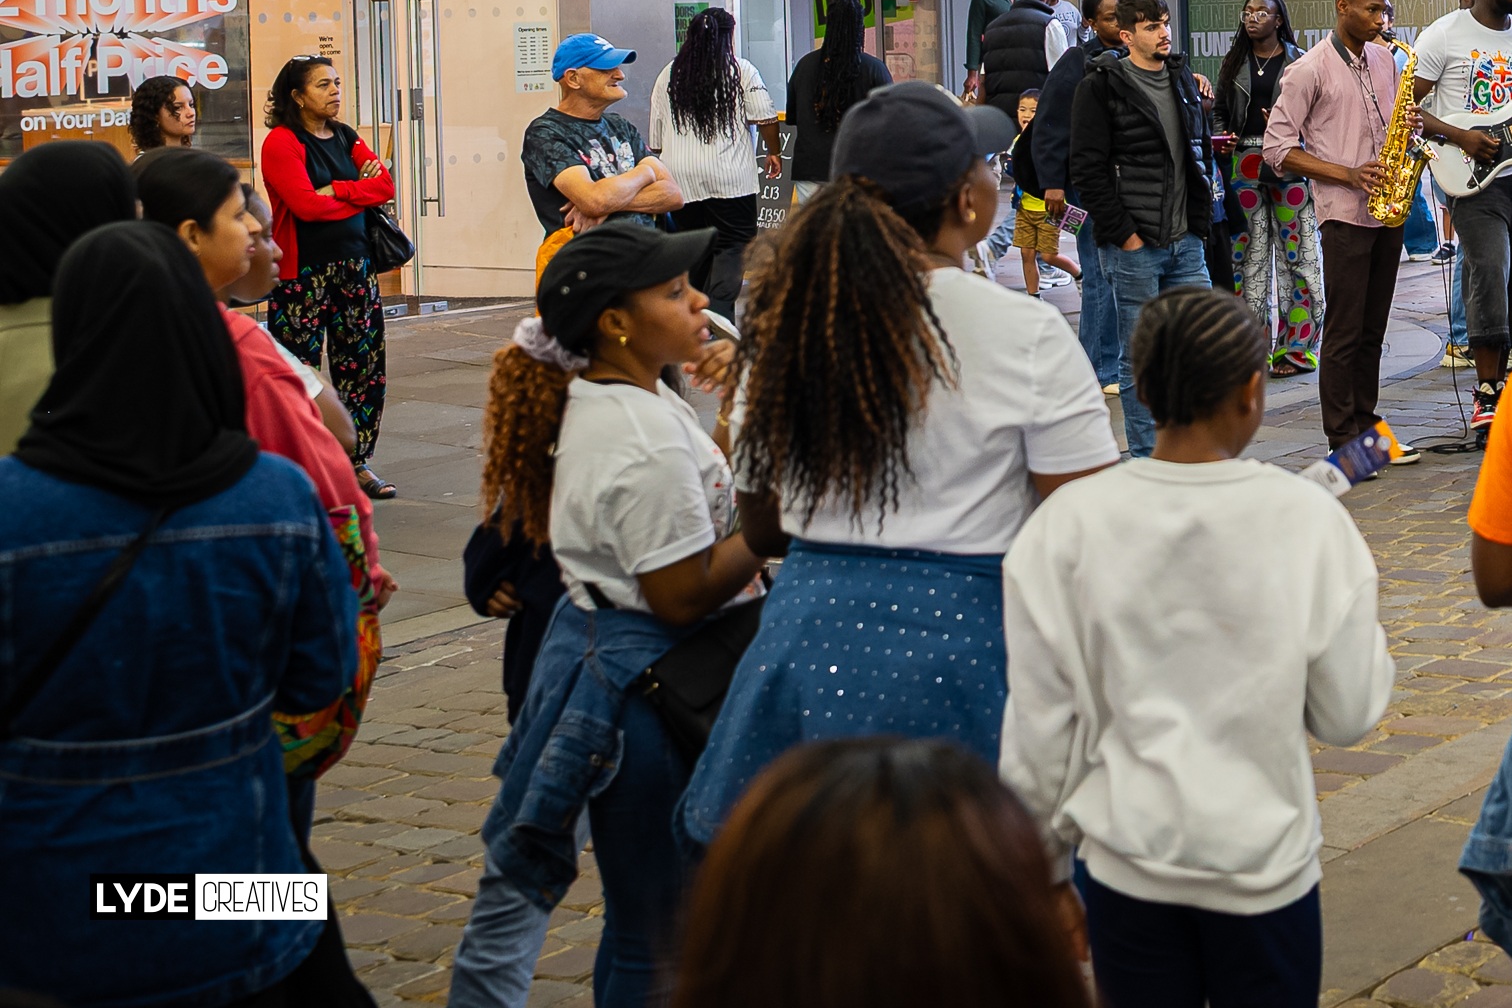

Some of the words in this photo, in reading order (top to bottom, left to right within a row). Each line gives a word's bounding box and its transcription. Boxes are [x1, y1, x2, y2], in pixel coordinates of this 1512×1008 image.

[20, 116, 46, 132] on
[50, 110, 96, 129] Your
[100, 108, 133, 127] Dat
